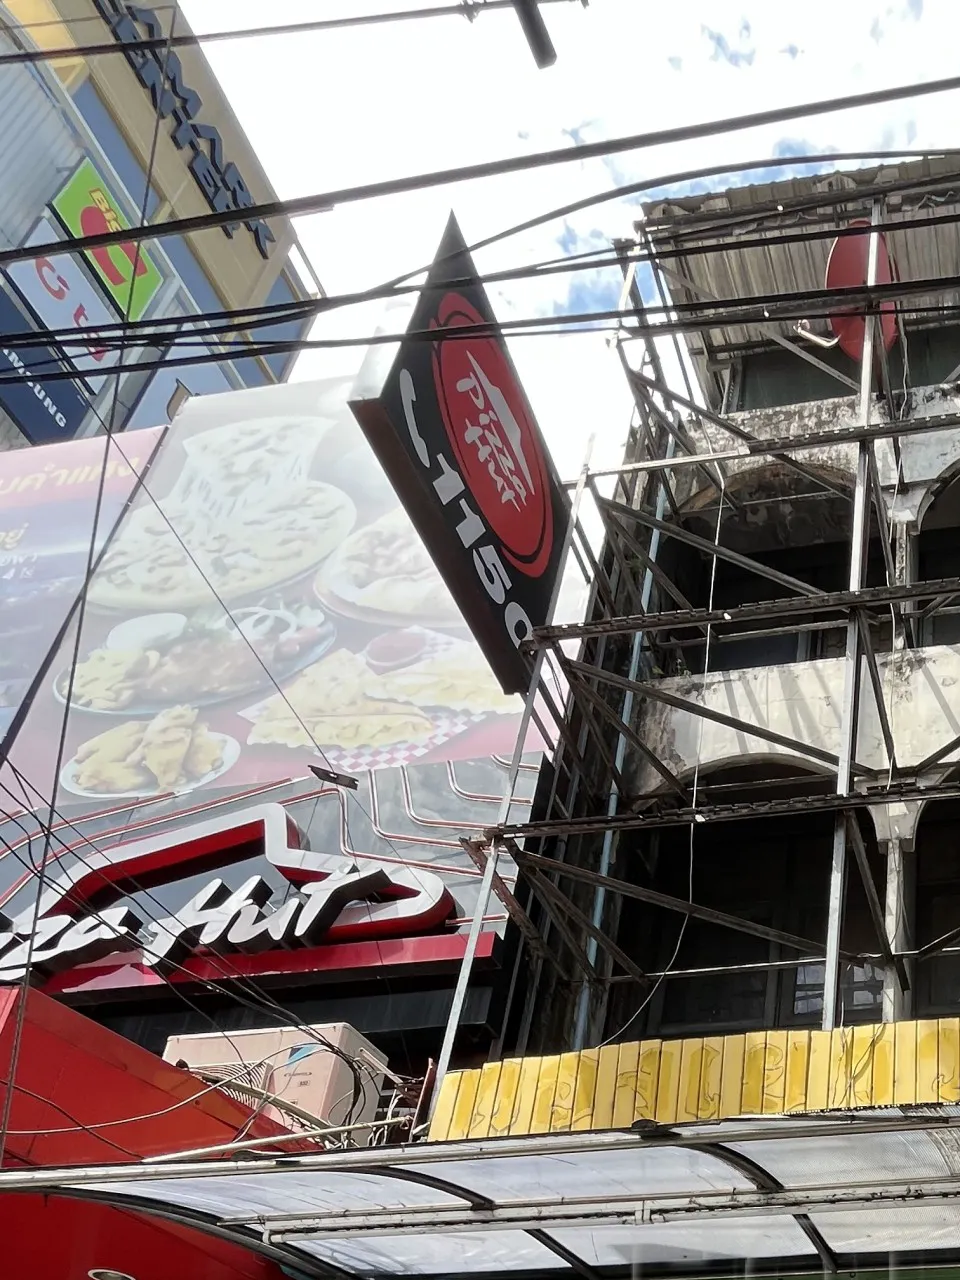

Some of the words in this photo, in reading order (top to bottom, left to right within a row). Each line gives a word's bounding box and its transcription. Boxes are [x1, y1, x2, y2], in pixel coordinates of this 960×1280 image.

[456, 371, 527, 507] Pizza
[464, 418, 521, 513] Hut
[143, 864, 392, 967] Hut
